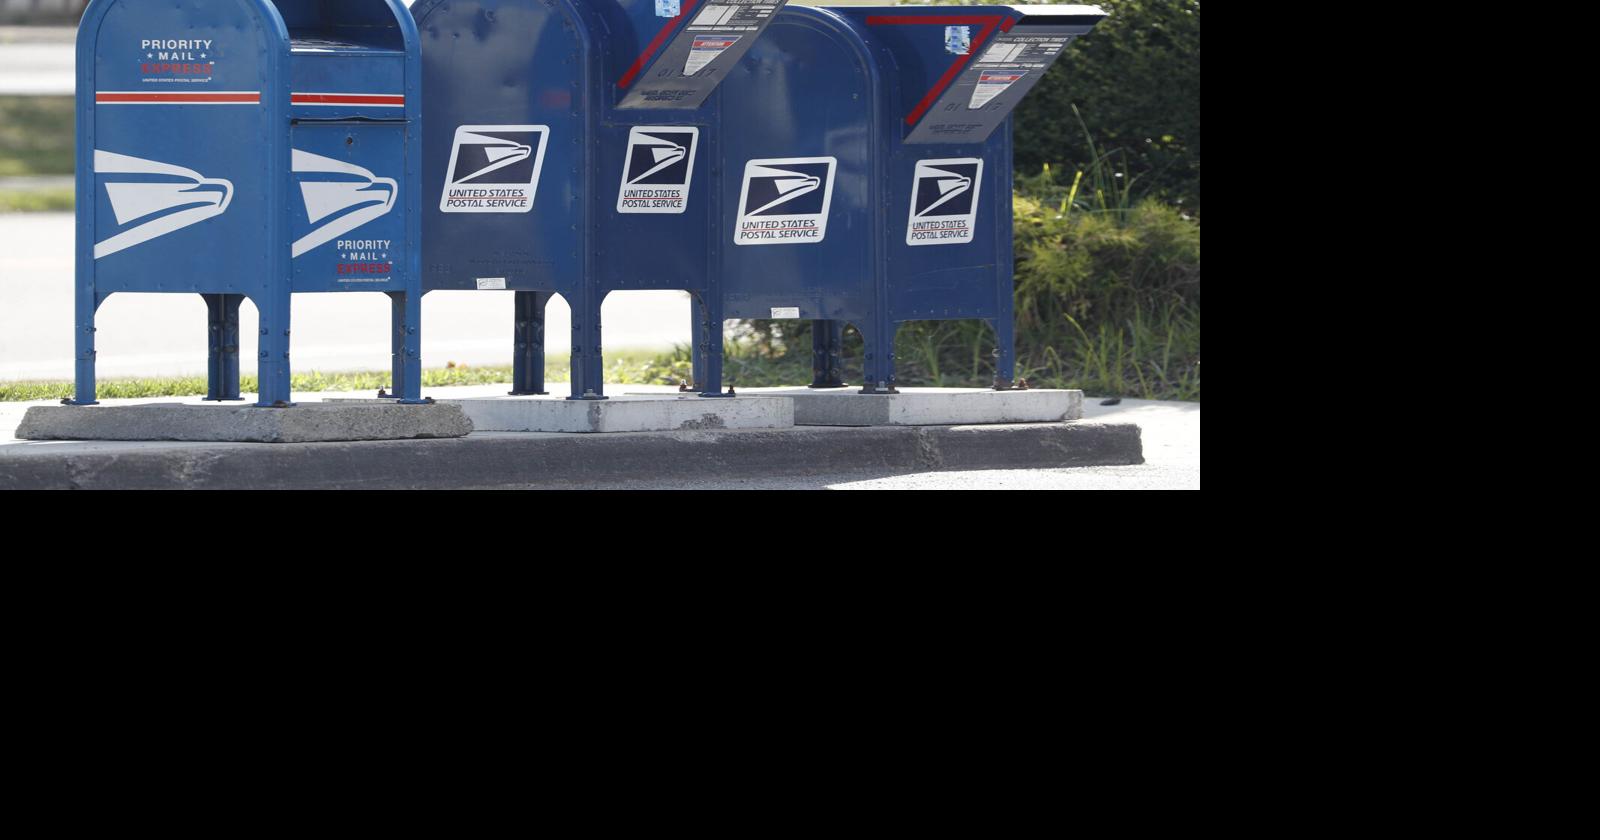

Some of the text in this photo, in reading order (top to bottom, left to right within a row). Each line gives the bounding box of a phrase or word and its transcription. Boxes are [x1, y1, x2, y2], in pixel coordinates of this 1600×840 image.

[141, 39, 213, 50] PRIORITY
[158, 51, 196, 61] MAIL
[141, 63, 213, 75] EXPRESS
[448, 189, 525, 198] UNITED STATES
[623, 189, 681, 198] UNITED STATES
[446, 199, 528, 208] POSTAL SERVICE
[622, 199, 683, 208] POSTAL SERVICE
[742, 219, 816, 230] UNITED STATES
[912, 220, 967, 230] UNITED STATES
[740, 229, 819, 240] POSTAL SERVICE
[911, 230, 969, 240] POSTAL SERVICE
[337, 240, 391, 250] PRIORITY
[350, 252, 379, 261] MAIL
[337, 263, 391, 274] EXPRESS
